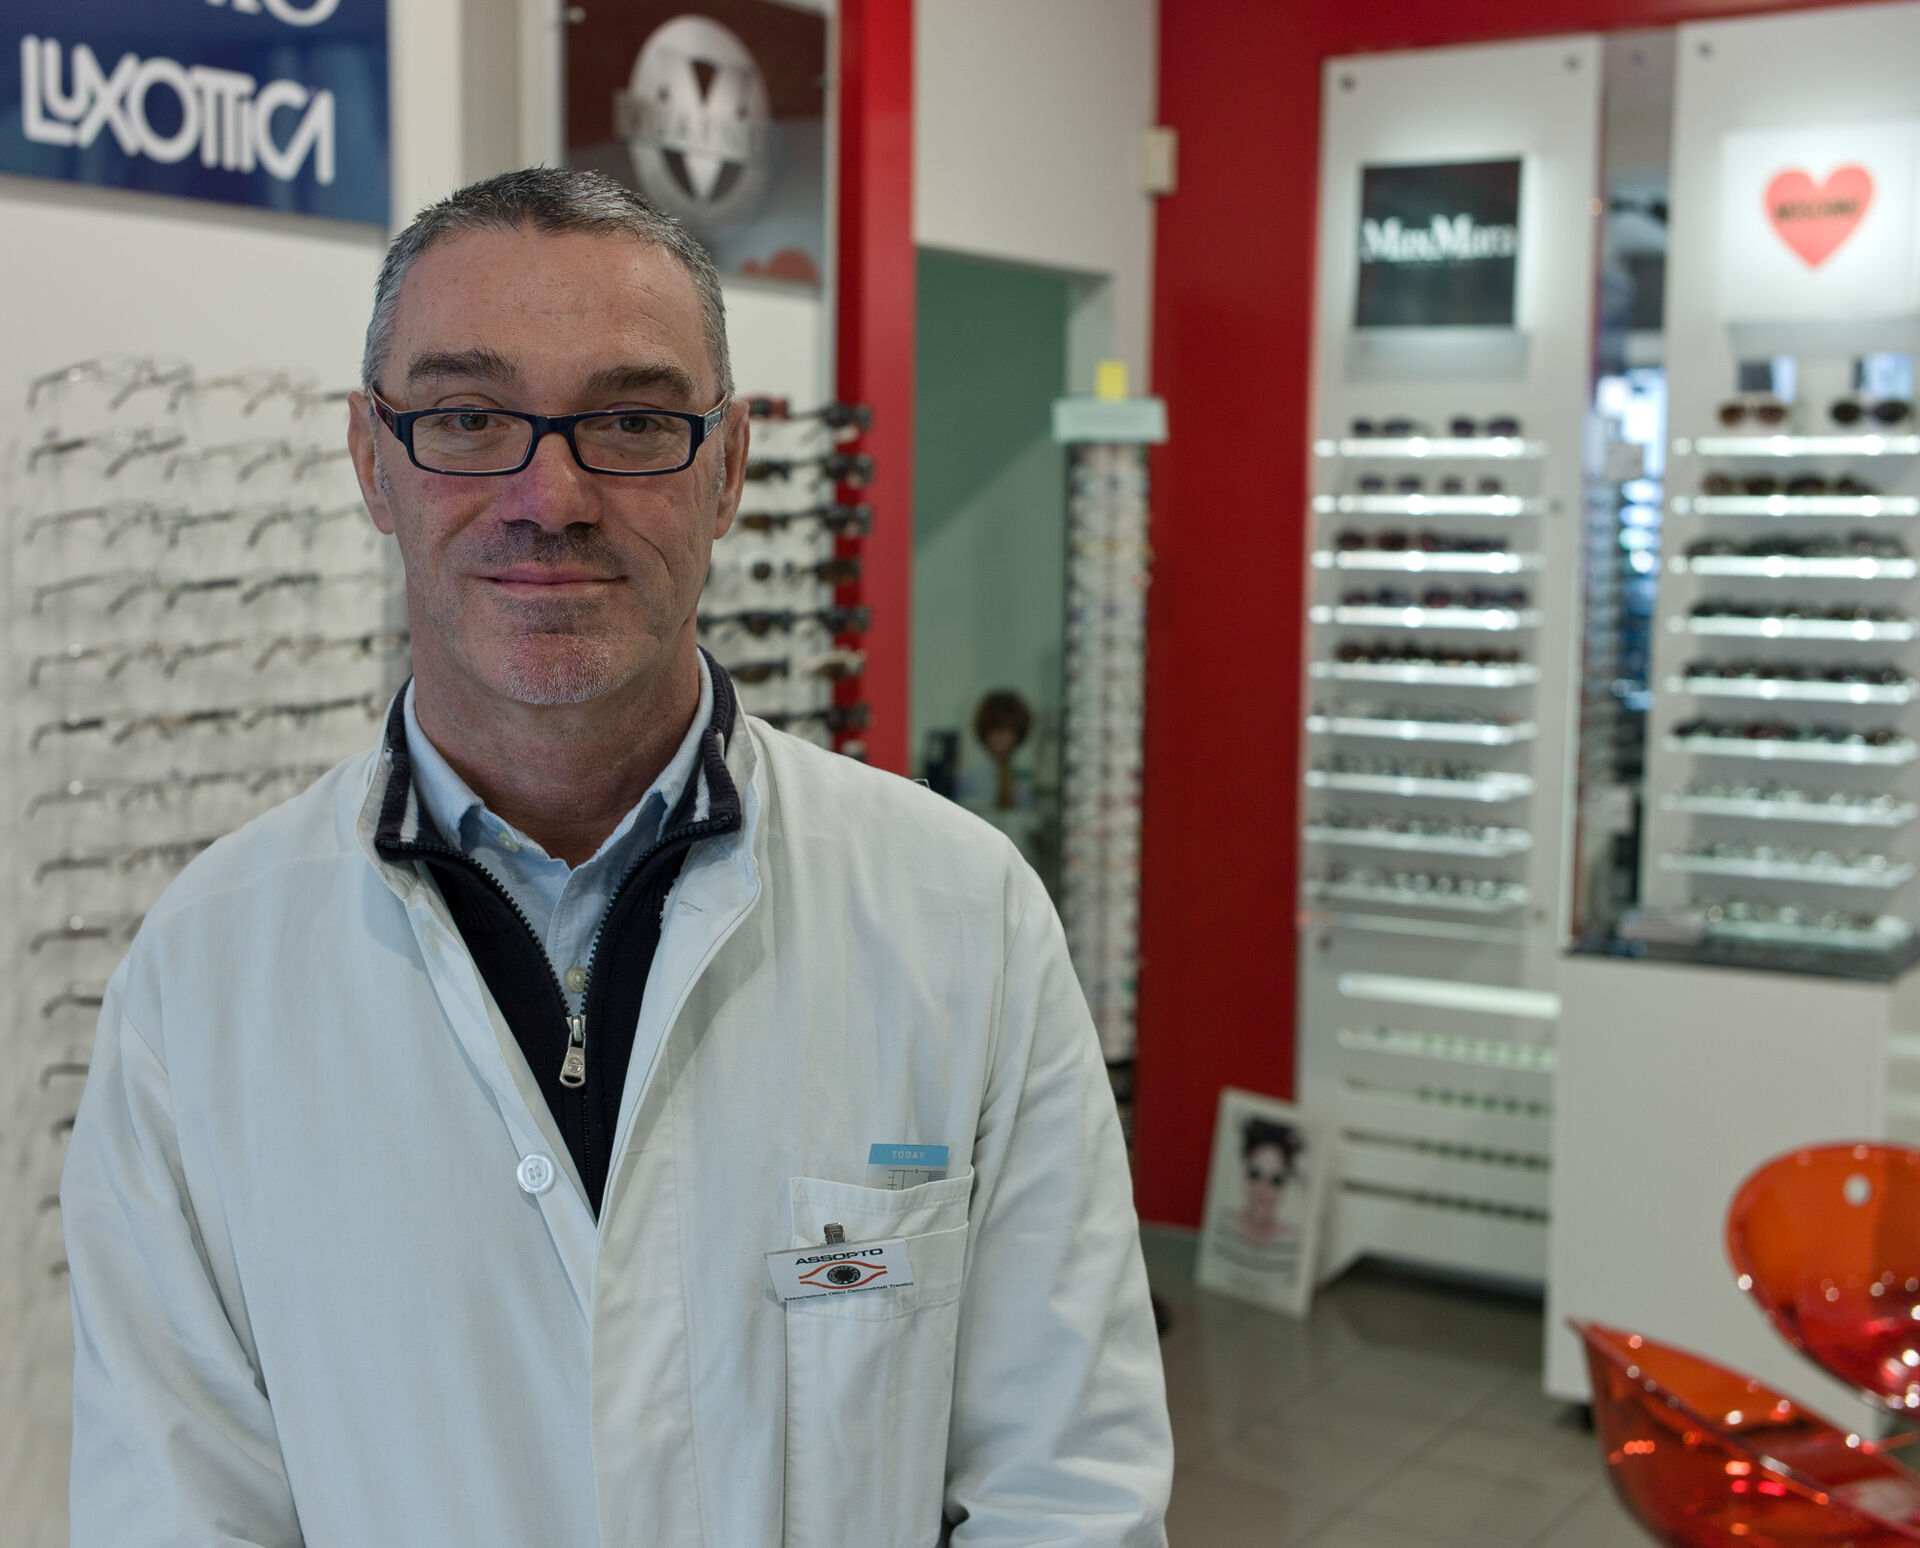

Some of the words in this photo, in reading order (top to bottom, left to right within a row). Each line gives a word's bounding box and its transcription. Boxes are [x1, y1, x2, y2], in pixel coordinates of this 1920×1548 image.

[20, 34, 336, 186] LUXOTTICA
[892, 1150, 926, 1160] TODAY
[795, 1248, 884, 1265] ASSOPTO
